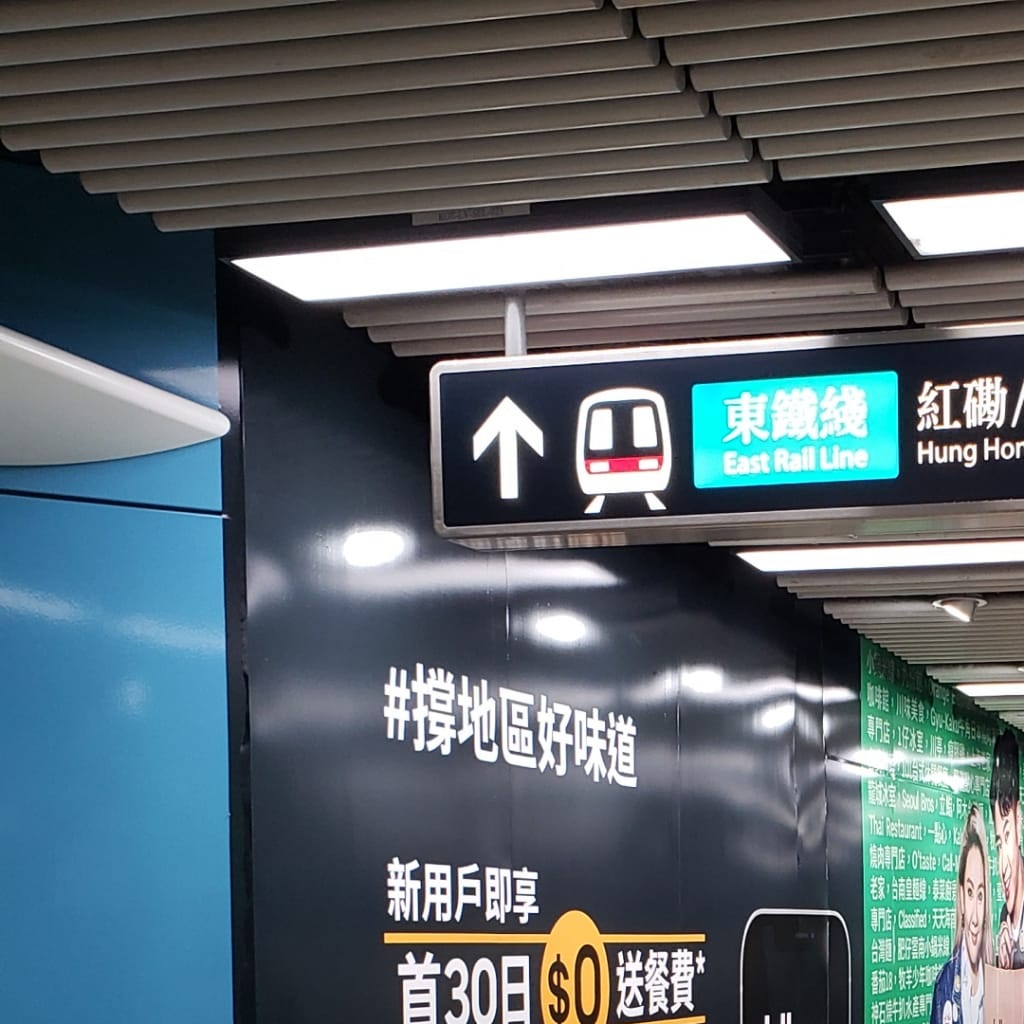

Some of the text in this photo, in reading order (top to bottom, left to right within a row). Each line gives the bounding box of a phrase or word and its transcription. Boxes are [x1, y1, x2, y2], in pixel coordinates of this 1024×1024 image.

[722, 384, 868, 445] 東鐵綫
[723, 445, 869, 475] East Rail Line
[917, 440, 977, 468] Hung
[386, 857, 540, 924] 新用戶即享
